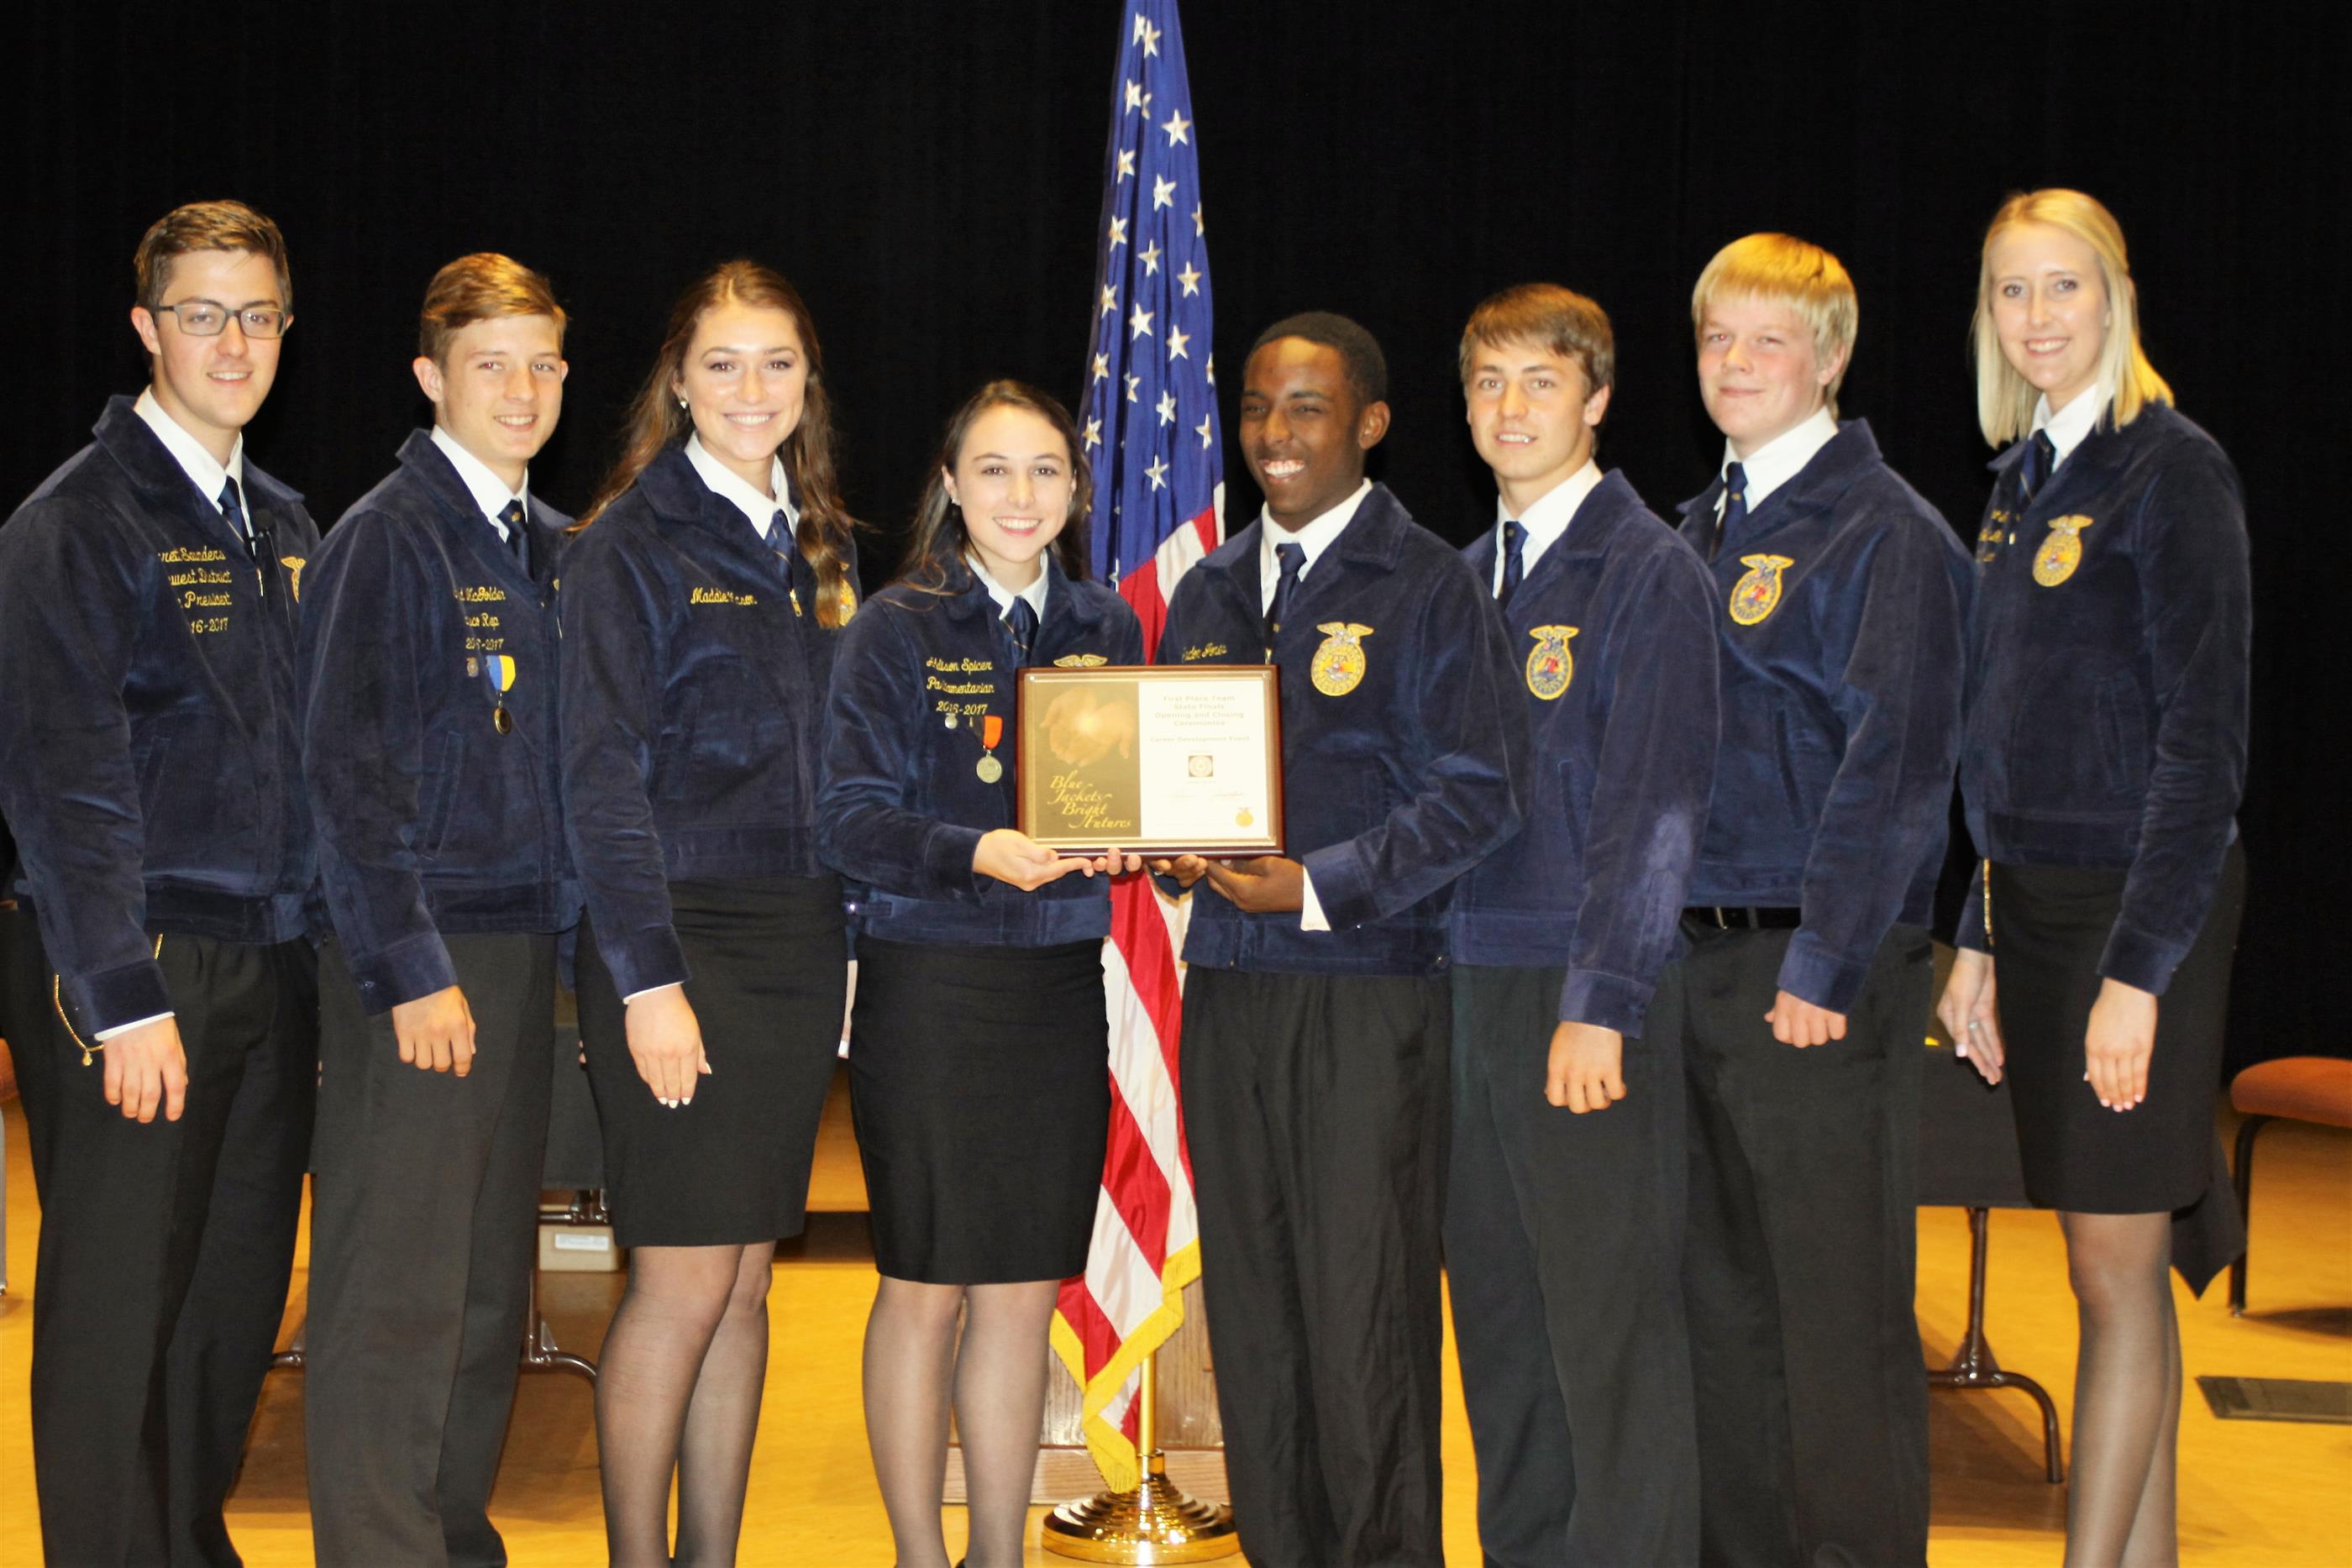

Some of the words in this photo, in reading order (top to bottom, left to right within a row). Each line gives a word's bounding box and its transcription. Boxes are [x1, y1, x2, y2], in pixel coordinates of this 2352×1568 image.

[184, 590, 232, 609] President
[961, 658, 993, 675] Spicer
[1049, 769, 1083, 789] Blue
[1047, 785, 1110, 805] Jackets
[1062, 802, 1107, 823] Bright
[1084, 815, 1131, 829] Futures
